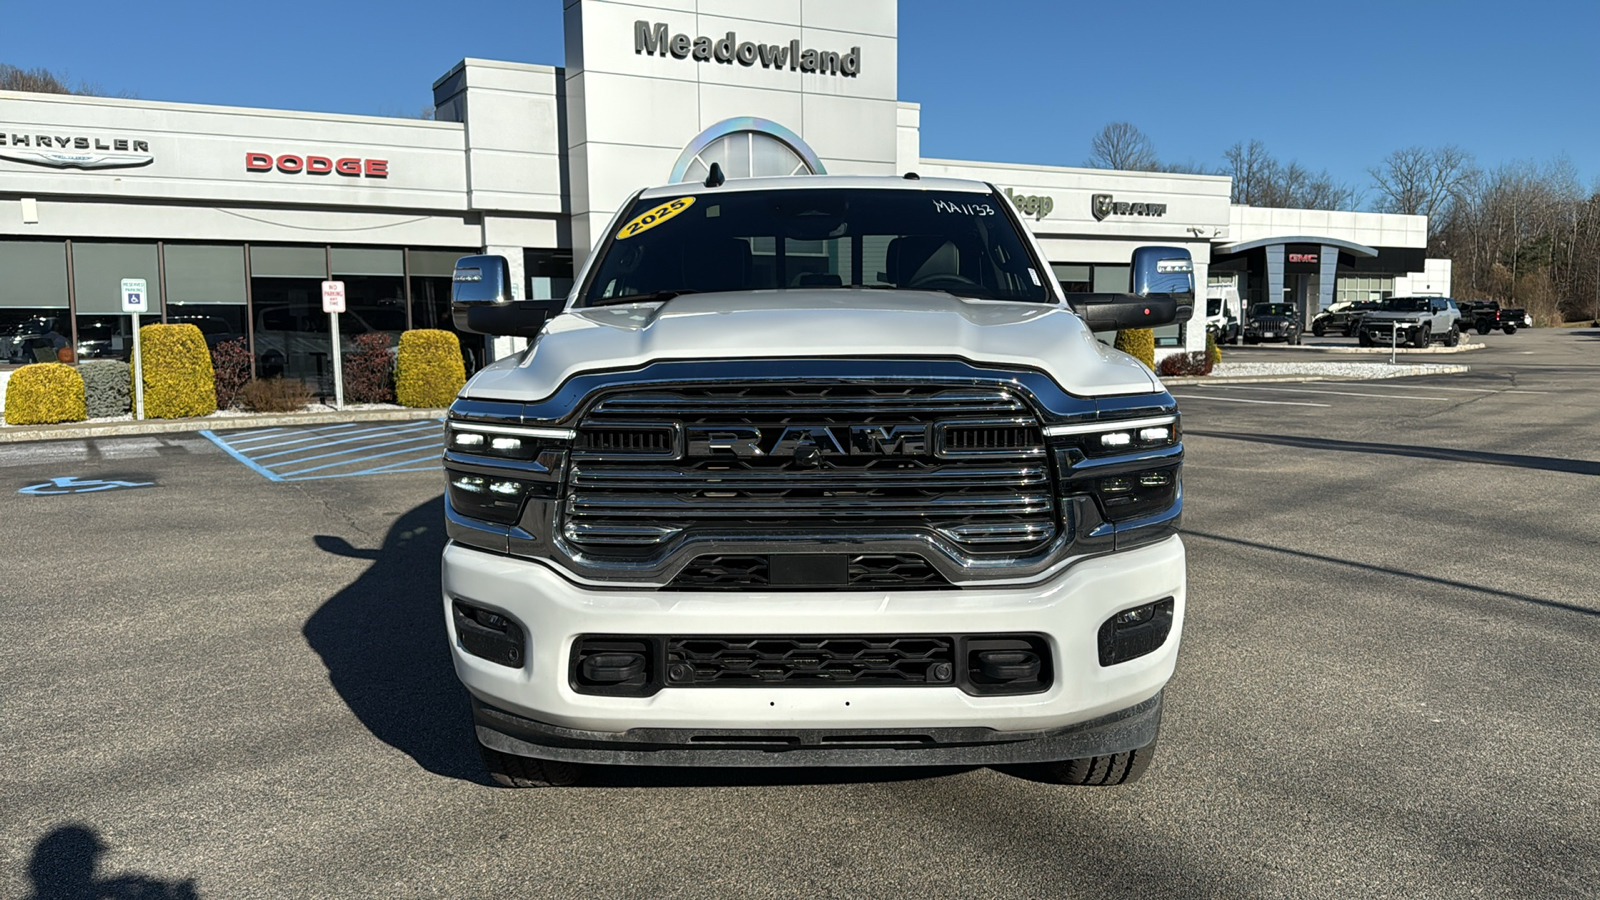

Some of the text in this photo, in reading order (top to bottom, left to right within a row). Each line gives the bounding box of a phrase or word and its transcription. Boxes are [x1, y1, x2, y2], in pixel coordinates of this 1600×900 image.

[634, 20, 861, 78] Meadowland
[246, 152, 388, 179] DODGE
[627, 200, 686, 235] 2025
[932, 199, 995, 216] MA1133
[1113, 202, 1167, 217] RAM
[1289, 253, 1318, 263] GMC
[687, 425, 928, 457] RAM
